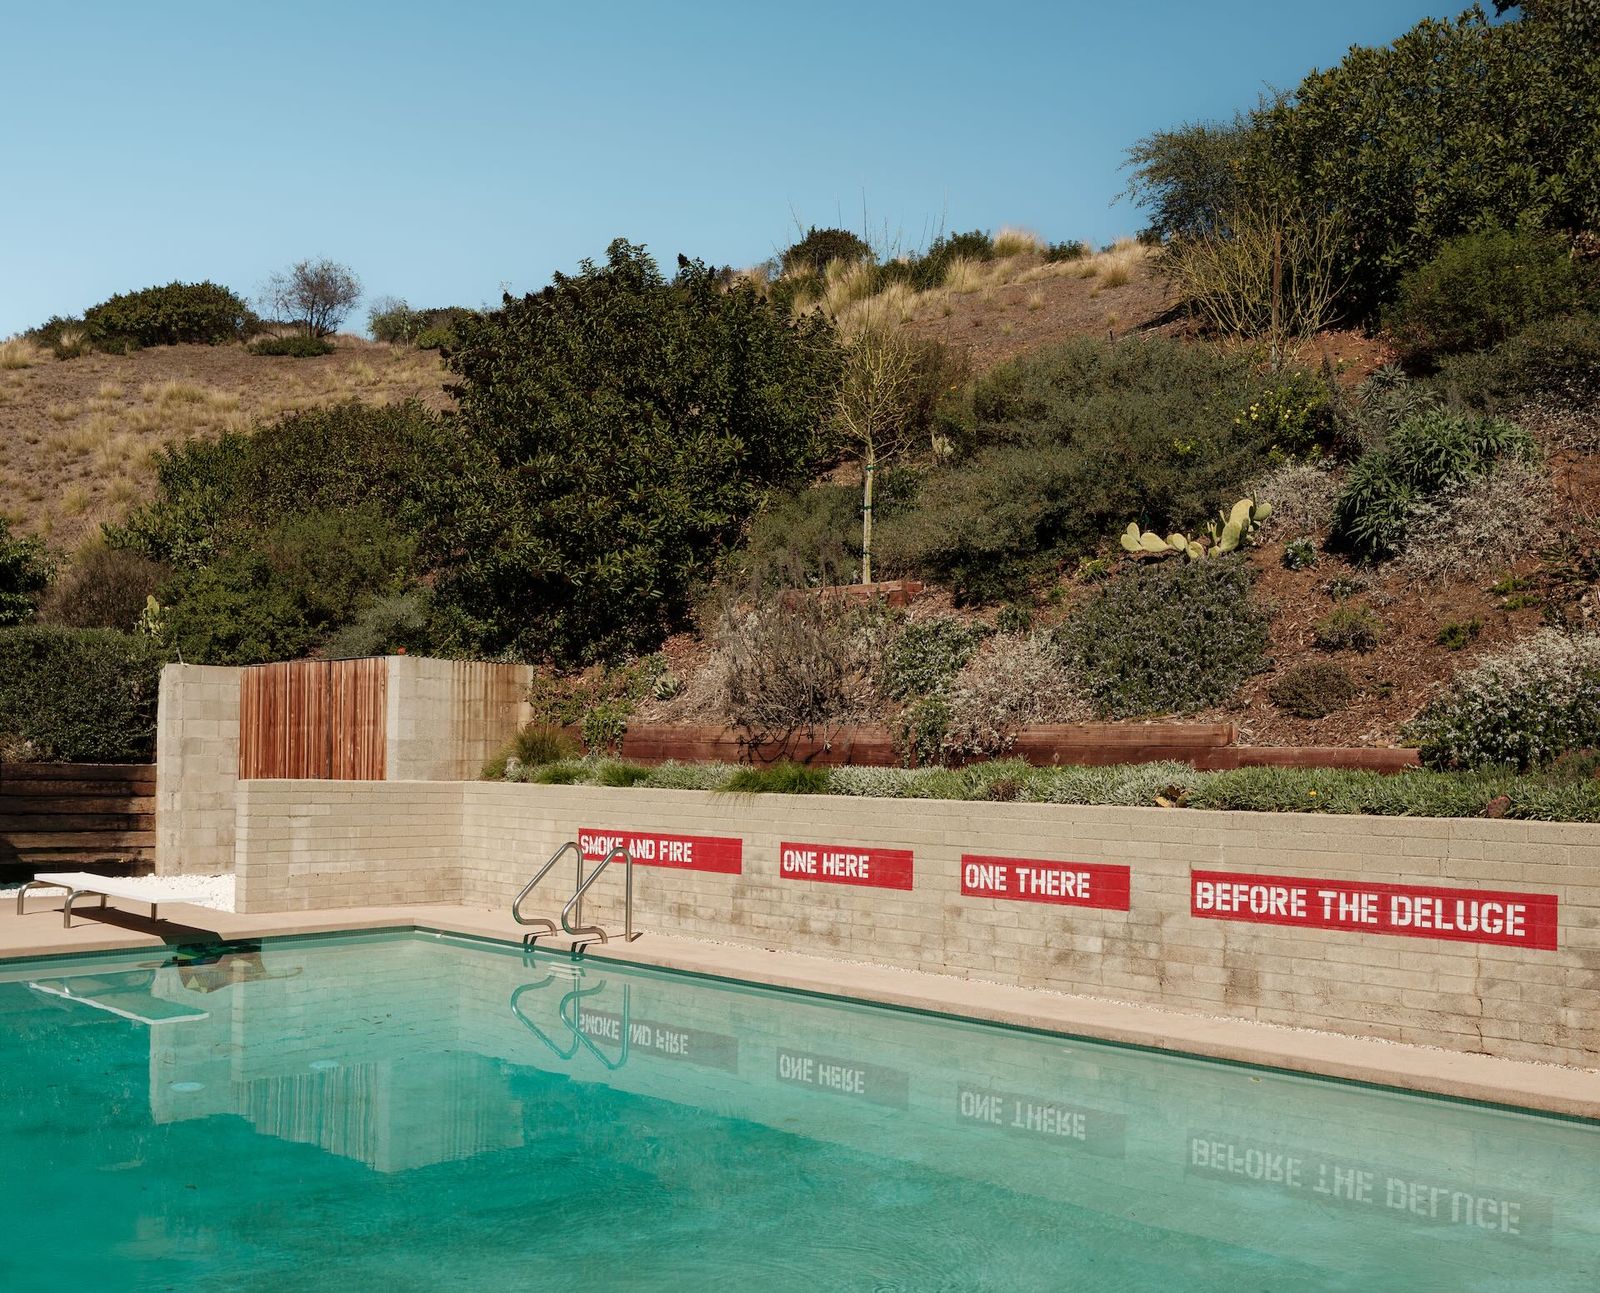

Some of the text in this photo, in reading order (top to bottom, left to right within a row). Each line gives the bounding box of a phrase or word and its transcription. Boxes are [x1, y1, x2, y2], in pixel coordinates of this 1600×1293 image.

[580, 835, 693, 863] SMOKE AND FIRE
[783, 850, 870, 879] ONE HERE
[965, 864, 1091, 899] ONE THERE
[1196, 882, 1526, 937] BEFORE THE DELUGE
